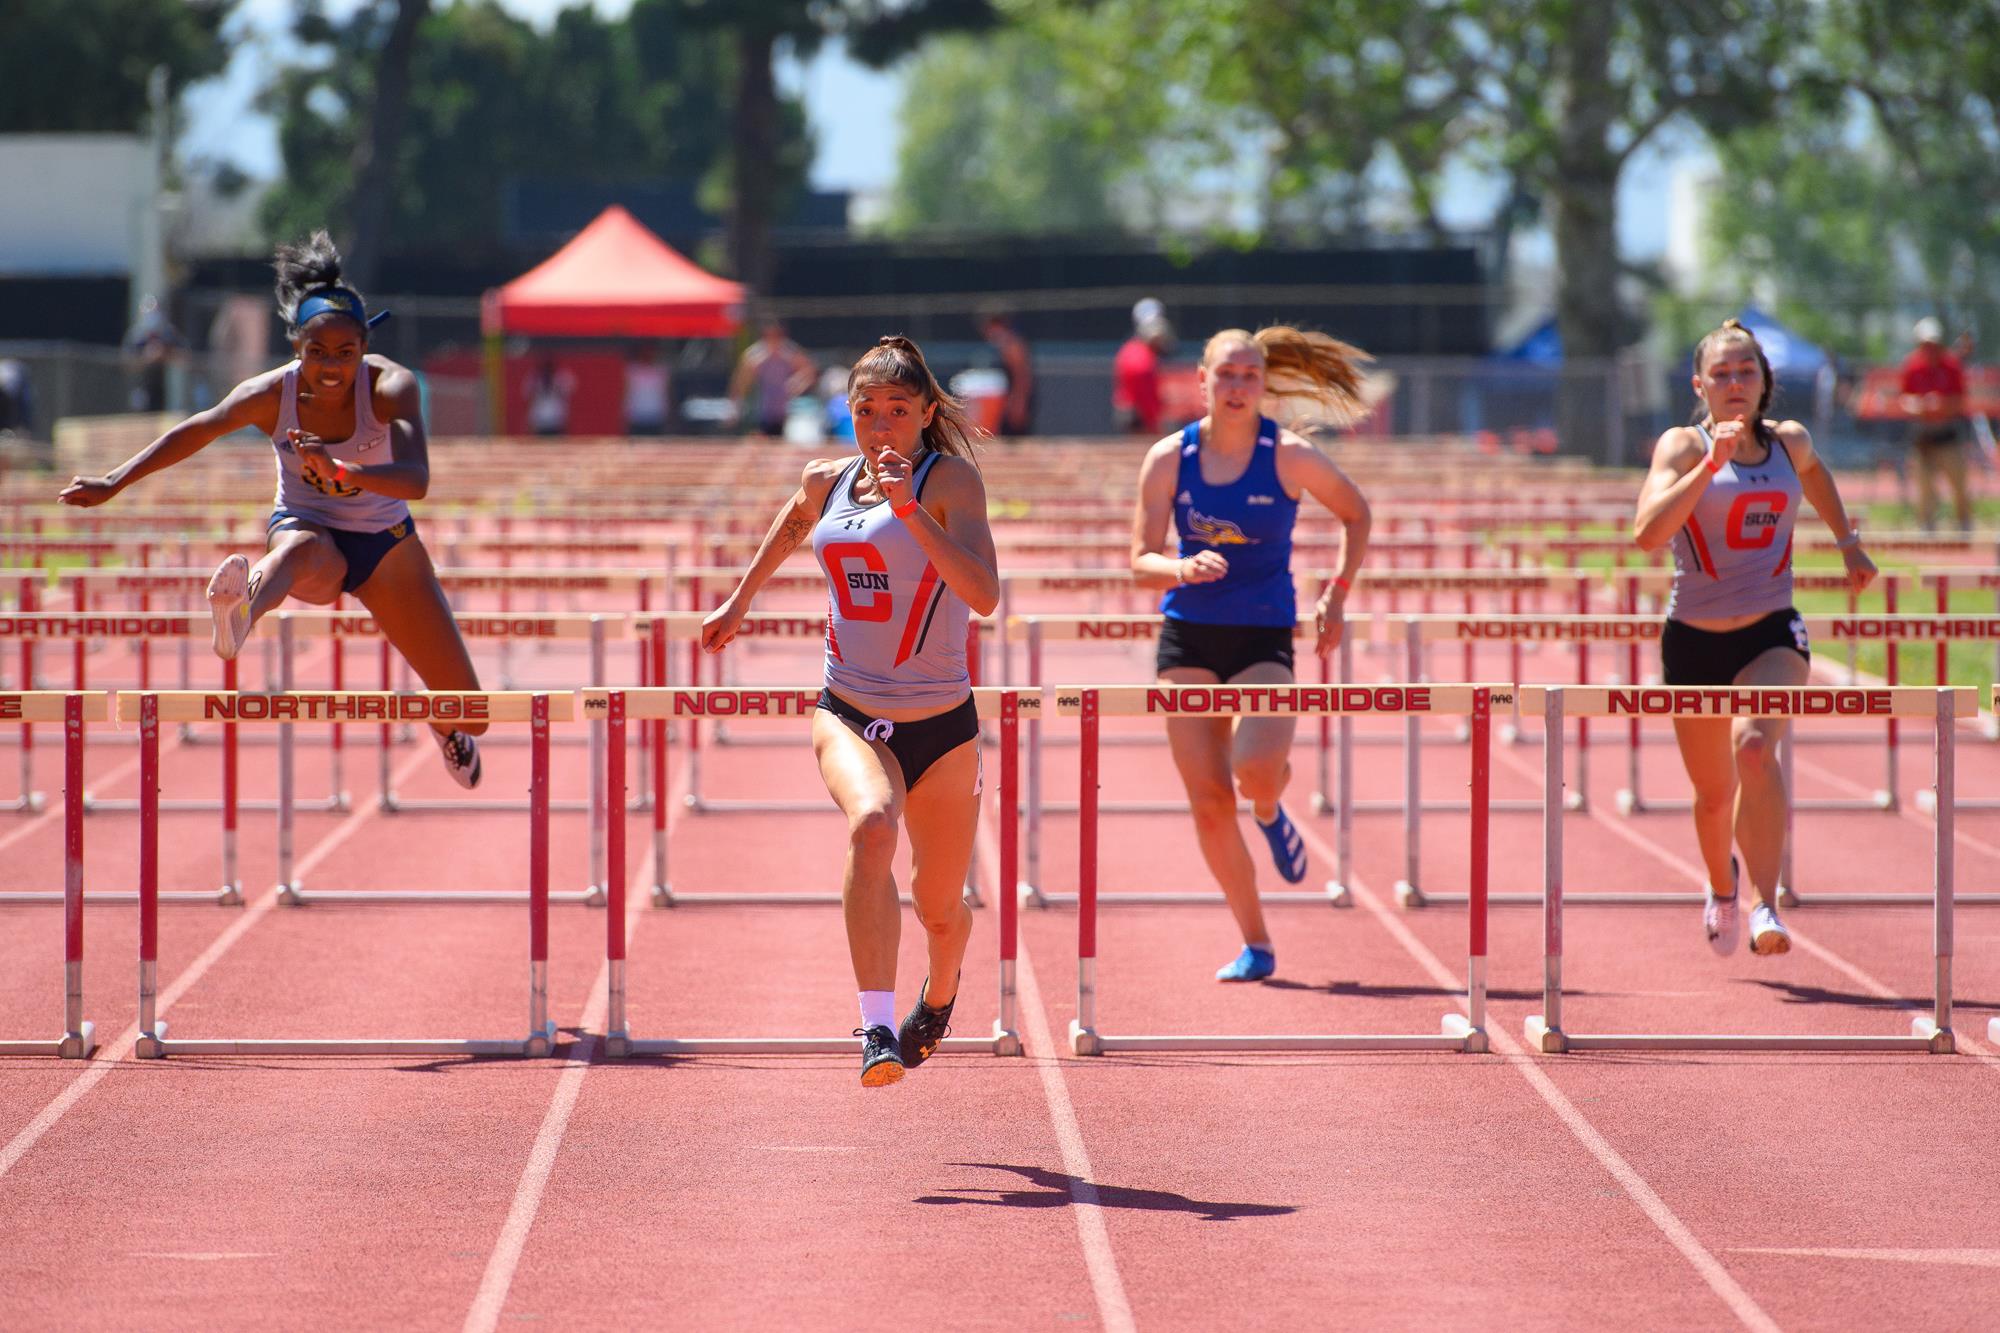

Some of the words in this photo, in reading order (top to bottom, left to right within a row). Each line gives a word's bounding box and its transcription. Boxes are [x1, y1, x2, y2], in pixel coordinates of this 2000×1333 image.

[847, 571, 890, 591] SUN
[0, 618, 190, 636] ORTHRIDGE
[332, 618, 556, 637] NORIDGE
[1457, 621, 1662, 639] NORTHRIDG
[1832, 620, 2000, 637] NORTHRI
[204, 695, 489, 719] NORTHRIDGE
[673, 691, 821, 715] NORTH
[1147, 687, 1431, 713] NORTHRIDGE
[1608, 690, 1892, 715] NORTHRIDGE
